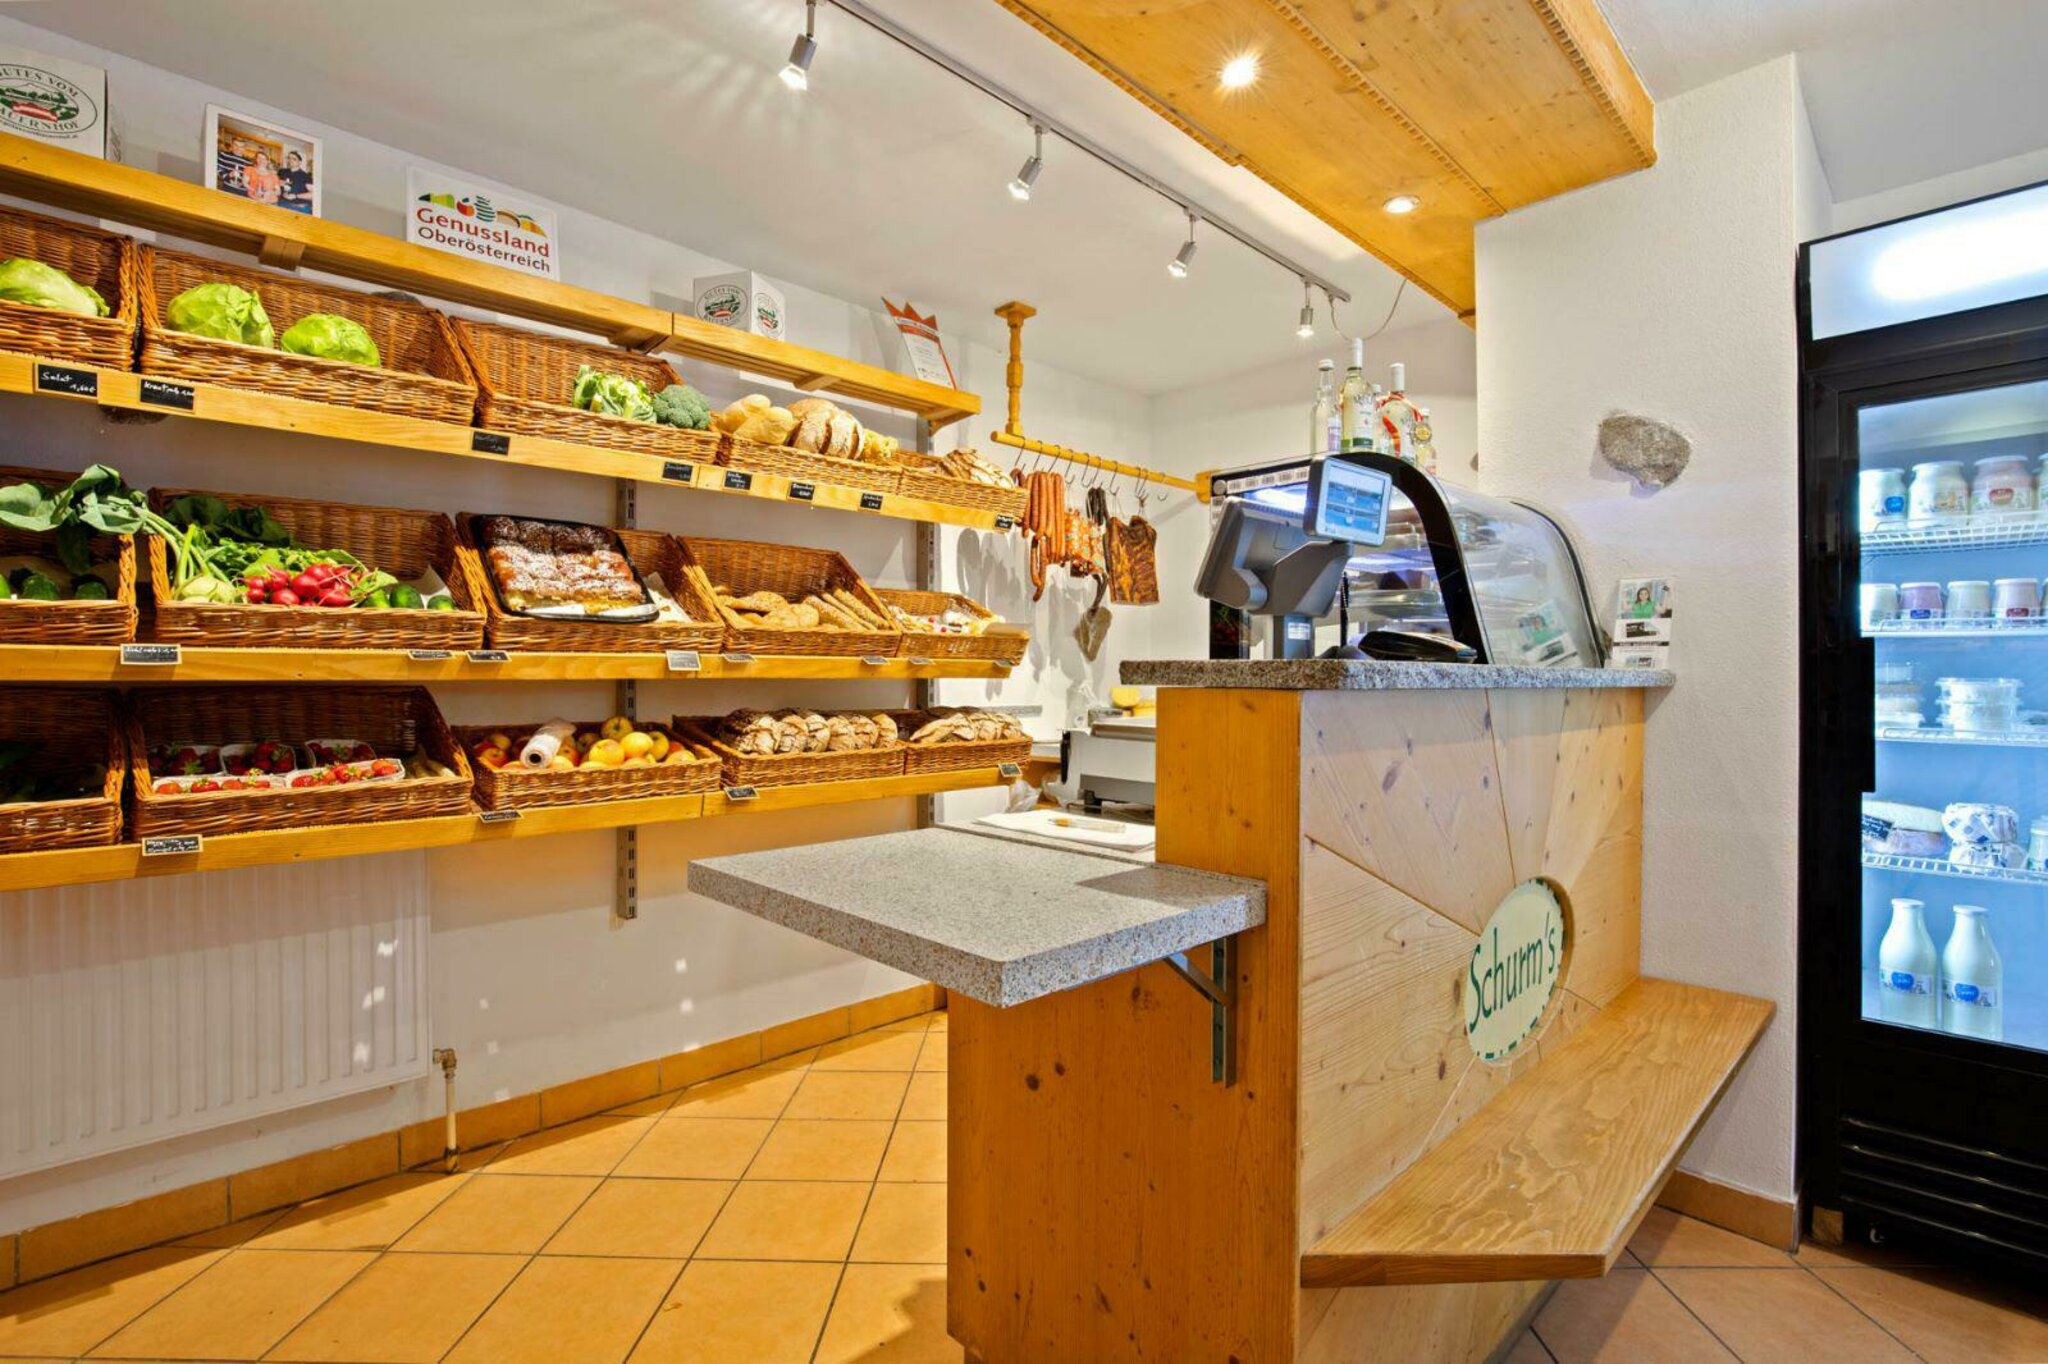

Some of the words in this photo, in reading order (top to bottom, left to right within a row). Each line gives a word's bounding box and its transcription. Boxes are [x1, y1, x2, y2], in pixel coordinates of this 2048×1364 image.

[0, 67, 42, 80] UTES
[49, 77, 79, 97] VOM
[416, 207, 550, 258] Genussland
[417, 226, 551, 273] Oberösterreich
[41, 371, 73, 383] Salat
[1469, 911, 1556, 1034] Schurm's
